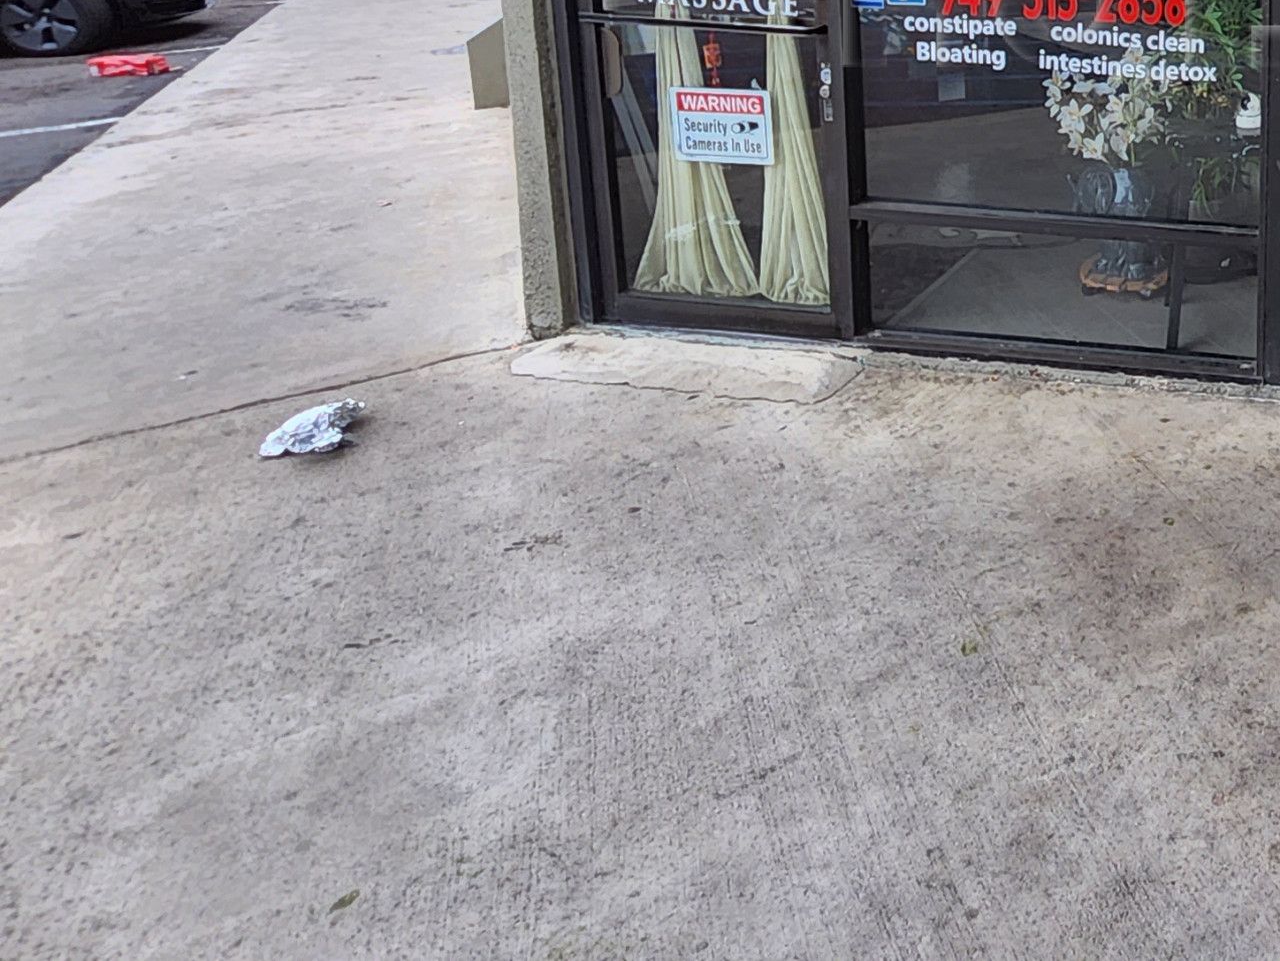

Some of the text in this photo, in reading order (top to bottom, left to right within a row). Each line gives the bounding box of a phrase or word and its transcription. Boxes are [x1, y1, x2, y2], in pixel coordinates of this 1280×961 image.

[904, 14, 1018, 38] constipate
[1051, 23, 1205, 54] colonics clean
[916, 42, 1006, 70] Bloating
[1039, 49, 1217, 82] intestines detox
[681, 94, 762, 113] WARNING
[684, 117, 728, 136] Security
[685, 136, 762, 154] Cameras In Use
